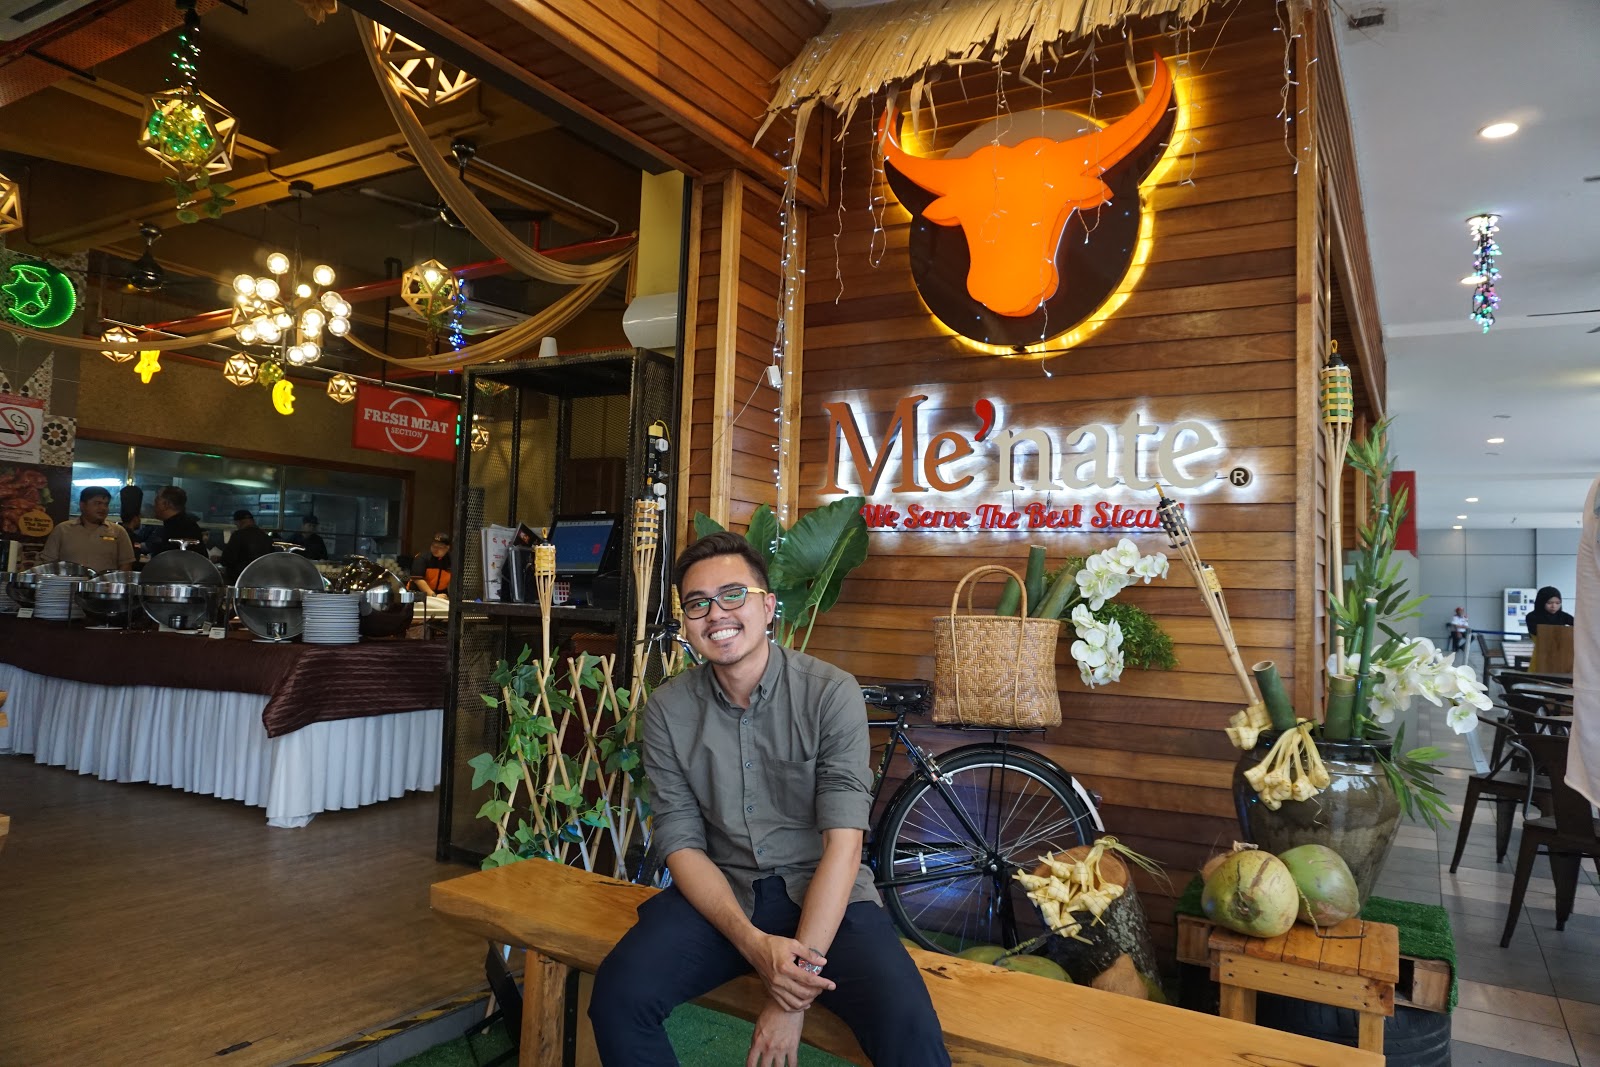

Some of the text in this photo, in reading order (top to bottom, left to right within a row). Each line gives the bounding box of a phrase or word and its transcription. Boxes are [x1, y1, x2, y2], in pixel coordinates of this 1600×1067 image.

[363, 408, 449, 434] FRESH MEAT
[390, 427, 423, 438] SECTION
[815, 395, 1219, 496] Me'nate
[859, 501, 1185, 529] We Serve The Best Stea
